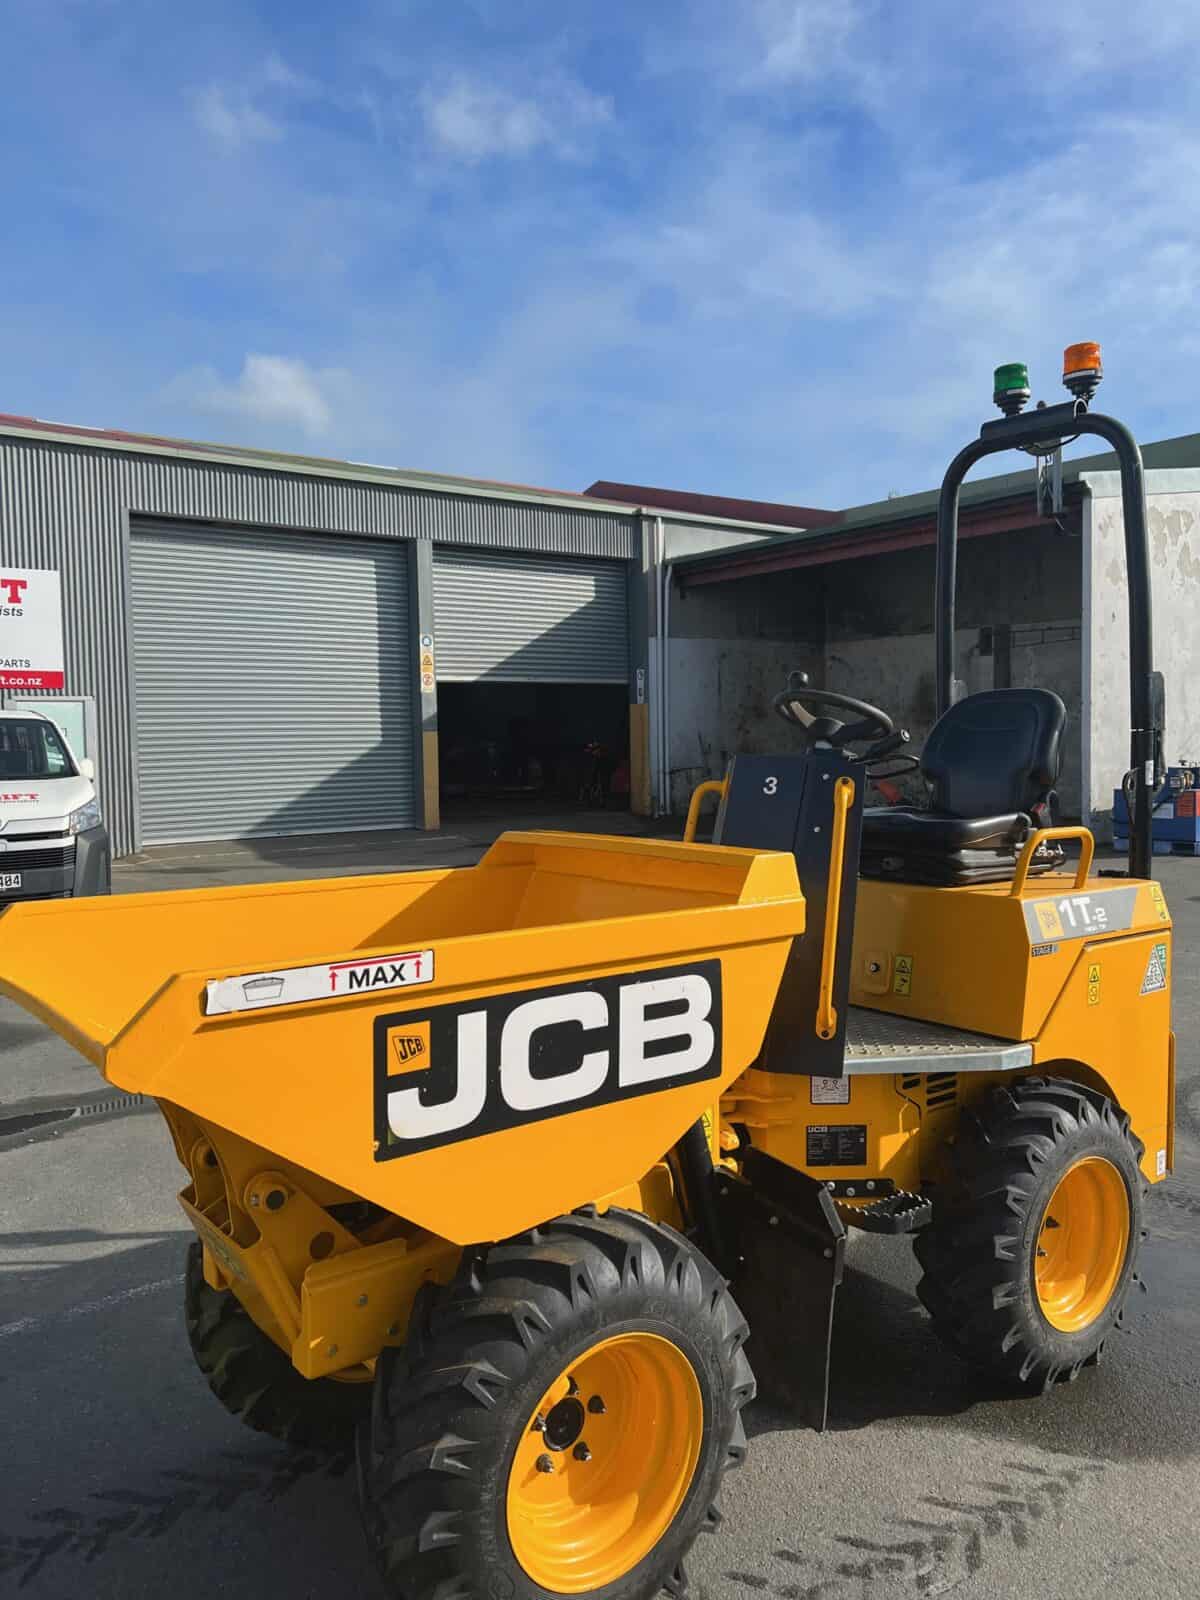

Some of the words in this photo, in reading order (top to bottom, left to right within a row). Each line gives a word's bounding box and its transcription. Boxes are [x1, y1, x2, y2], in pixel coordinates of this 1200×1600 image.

[763, 776, 778, 795] 3
[348, 963, 407, 990] MAX
[387, 974, 715, 1140] JCB
[399, 1038, 424, 1061] JCB
